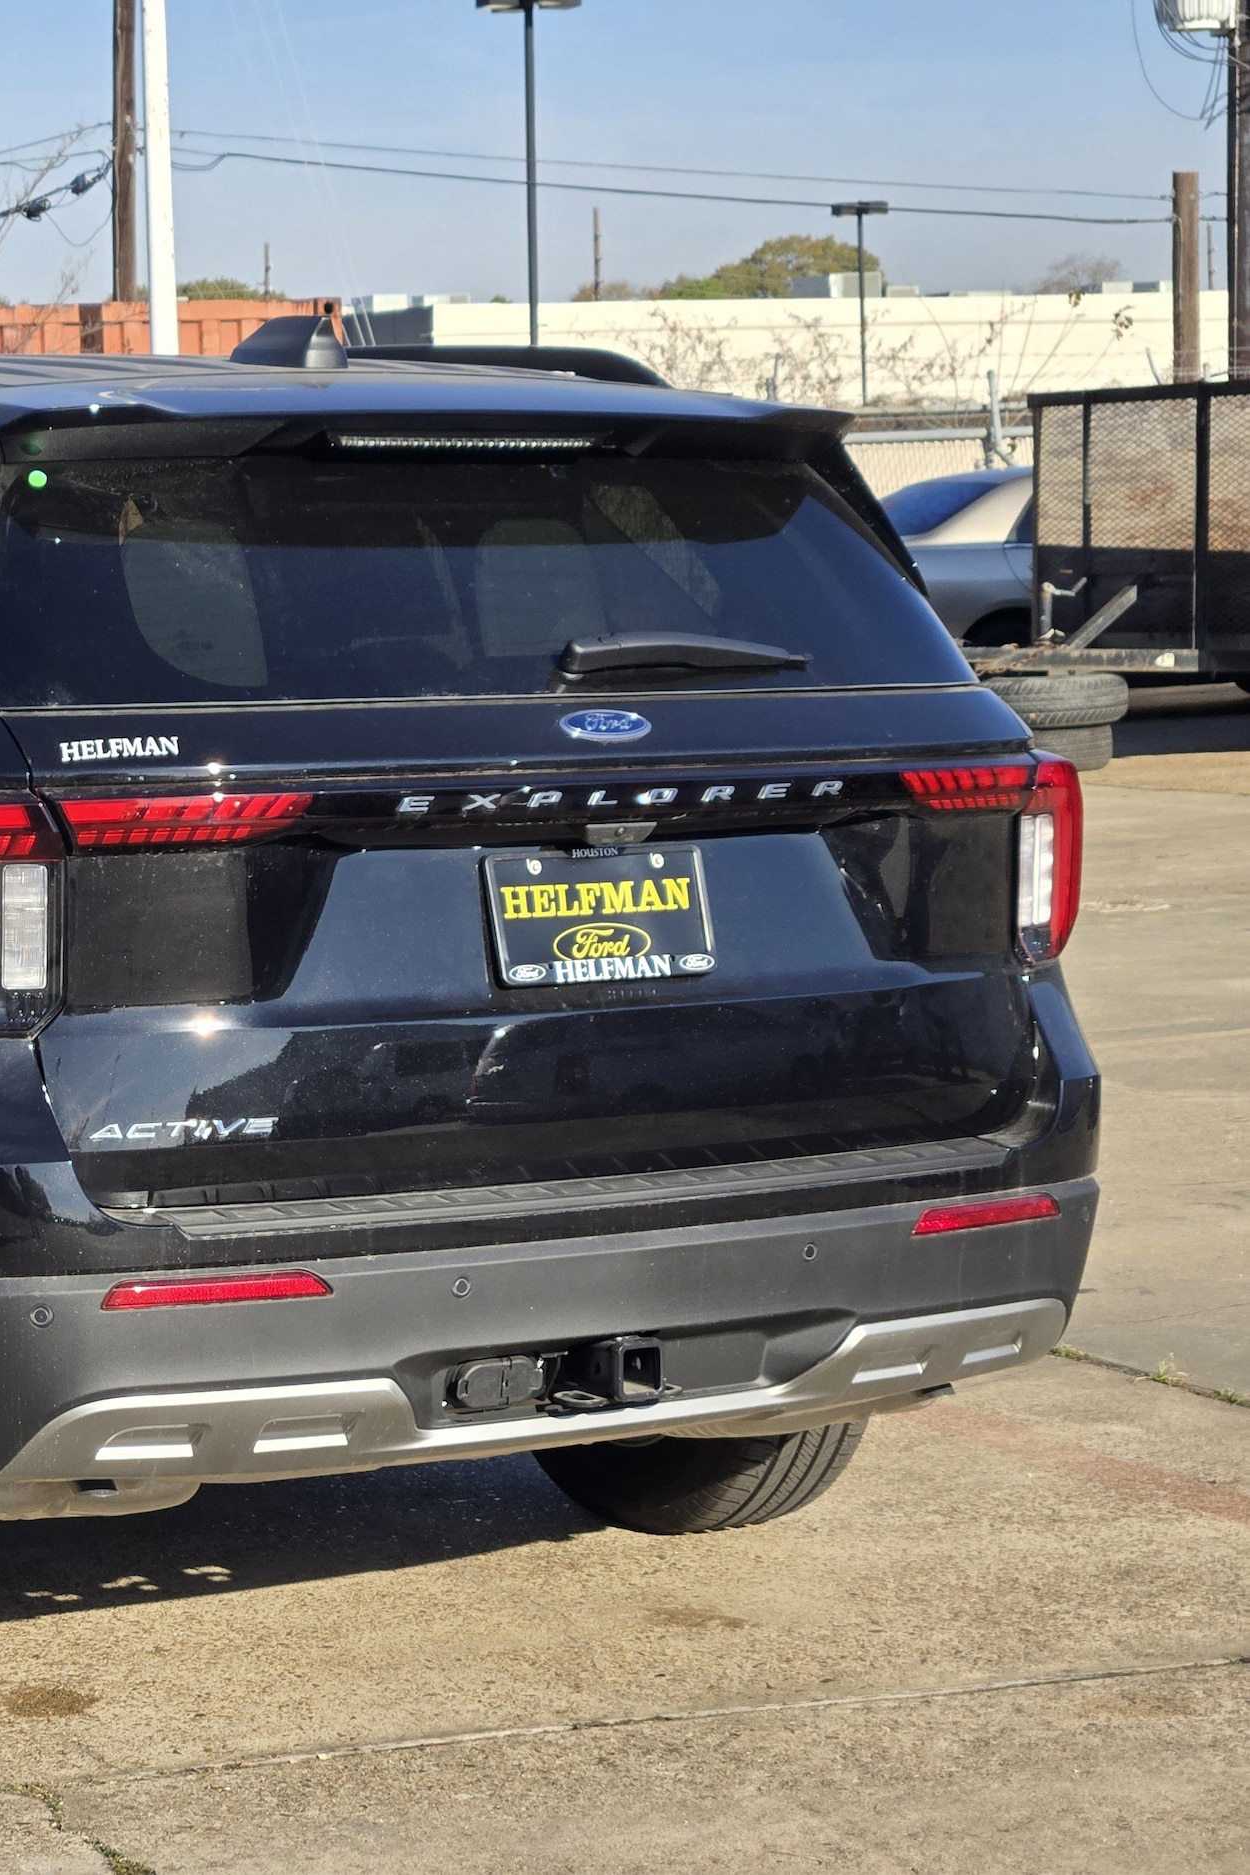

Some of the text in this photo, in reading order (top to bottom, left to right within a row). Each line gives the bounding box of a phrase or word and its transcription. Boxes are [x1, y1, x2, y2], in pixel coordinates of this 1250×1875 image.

[59, 736, 179, 762] HELFMAN
[395, 780, 845, 814] EXPLORER
[571, 847, 619, 859] HOUSTON
[500, 878, 691, 919] HELFMAN
[571, 928, 631, 958] Ford
[553, 954, 673, 984] HELFMAN
[89, 1116, 279, 1140] ACTIVE
